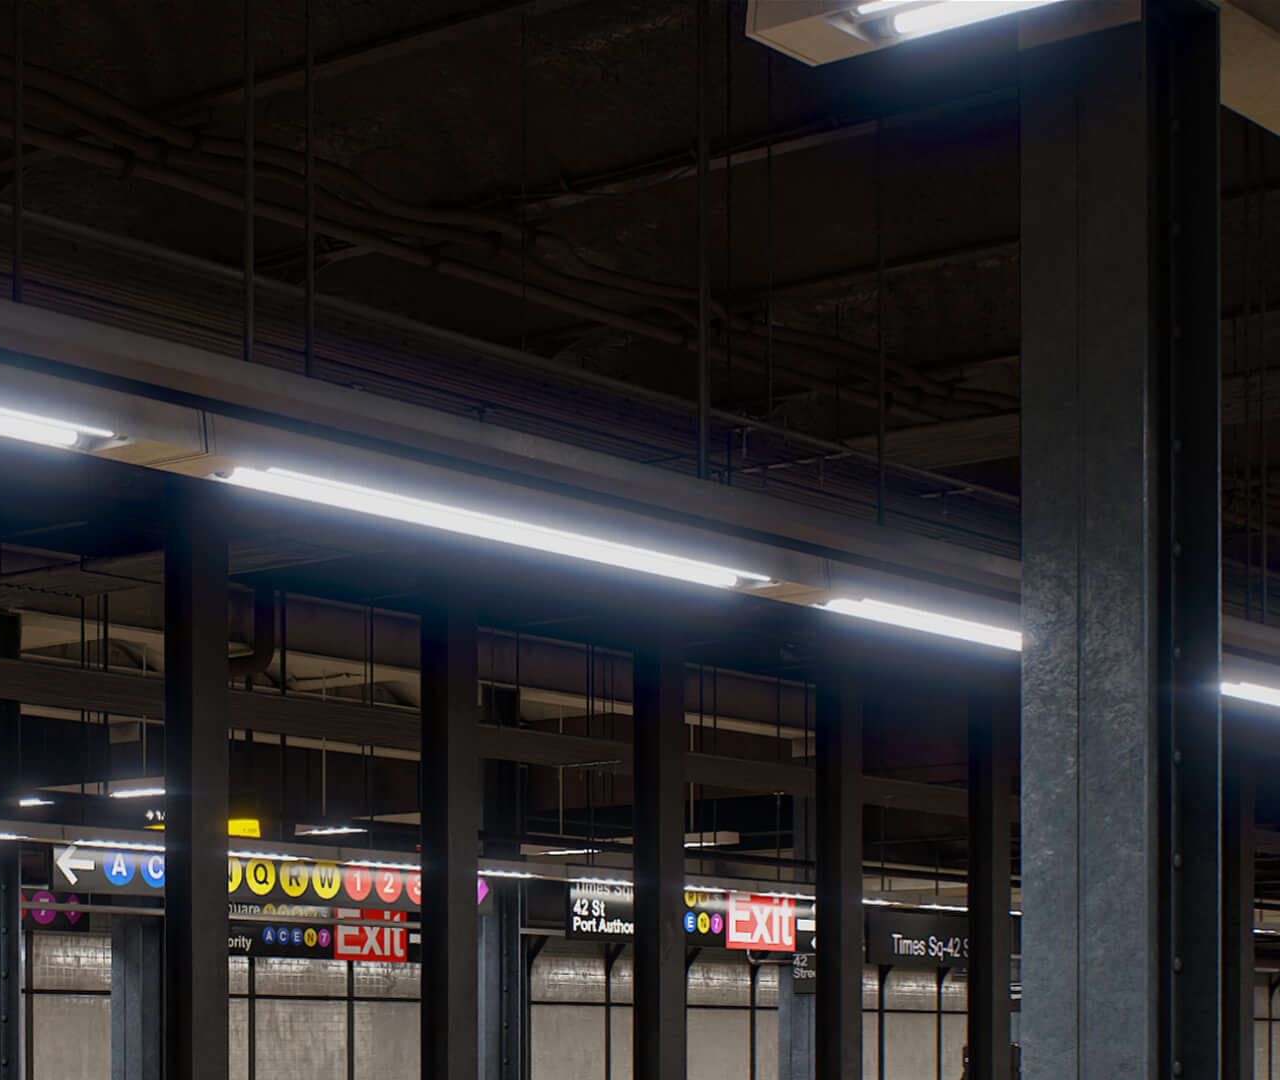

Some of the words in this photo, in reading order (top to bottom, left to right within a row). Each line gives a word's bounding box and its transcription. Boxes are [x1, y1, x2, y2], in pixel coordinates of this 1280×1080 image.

[111, 852, 127, 876] A
[148, 856, 164, 879] C
[253, 863, 270, 885] Q
[573, 898, 589, 915] 42
[591, 899, 605, 917] St
[573, 916, 596, 932] Port
[728, 893, 793, 946] Exit
[337, 907, 405, 957] Exit
[891, 933, 926, 956] Times
[793, 957, 808, 967] 42
